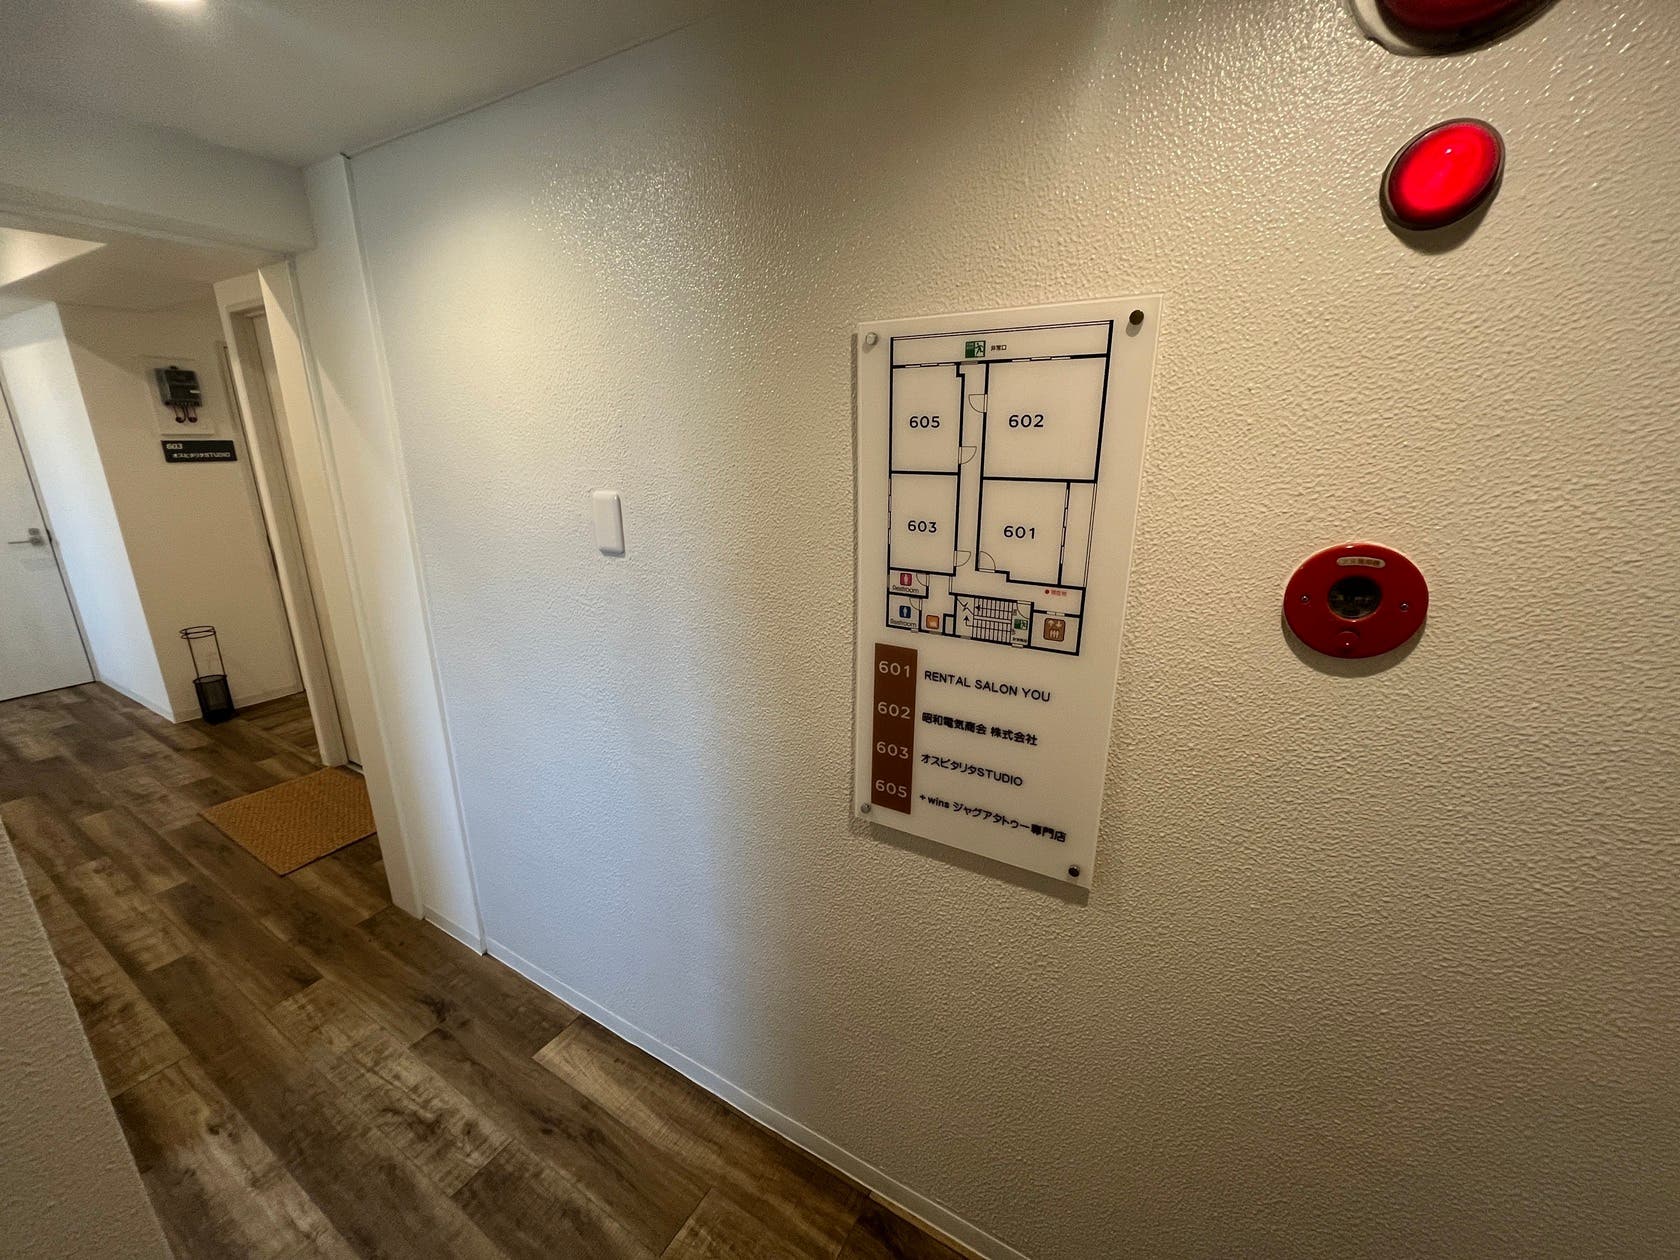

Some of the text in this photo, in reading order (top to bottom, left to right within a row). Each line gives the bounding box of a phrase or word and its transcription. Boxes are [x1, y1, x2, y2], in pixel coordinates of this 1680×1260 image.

[909, 416, 940, 429] 605
[1008, 414, 1044, 428] 602
[907, 520, 937, 533] 603
[1003, 525, 1035, 540] 601
[878, 660, 1051, 703] 601 RENTAL SALON YOU
[877, 701, 1038, 746] 602 昭和電気商会 株式会社
[876, 741, 910, 760] 603
[875, 779, 908, 799] 605
